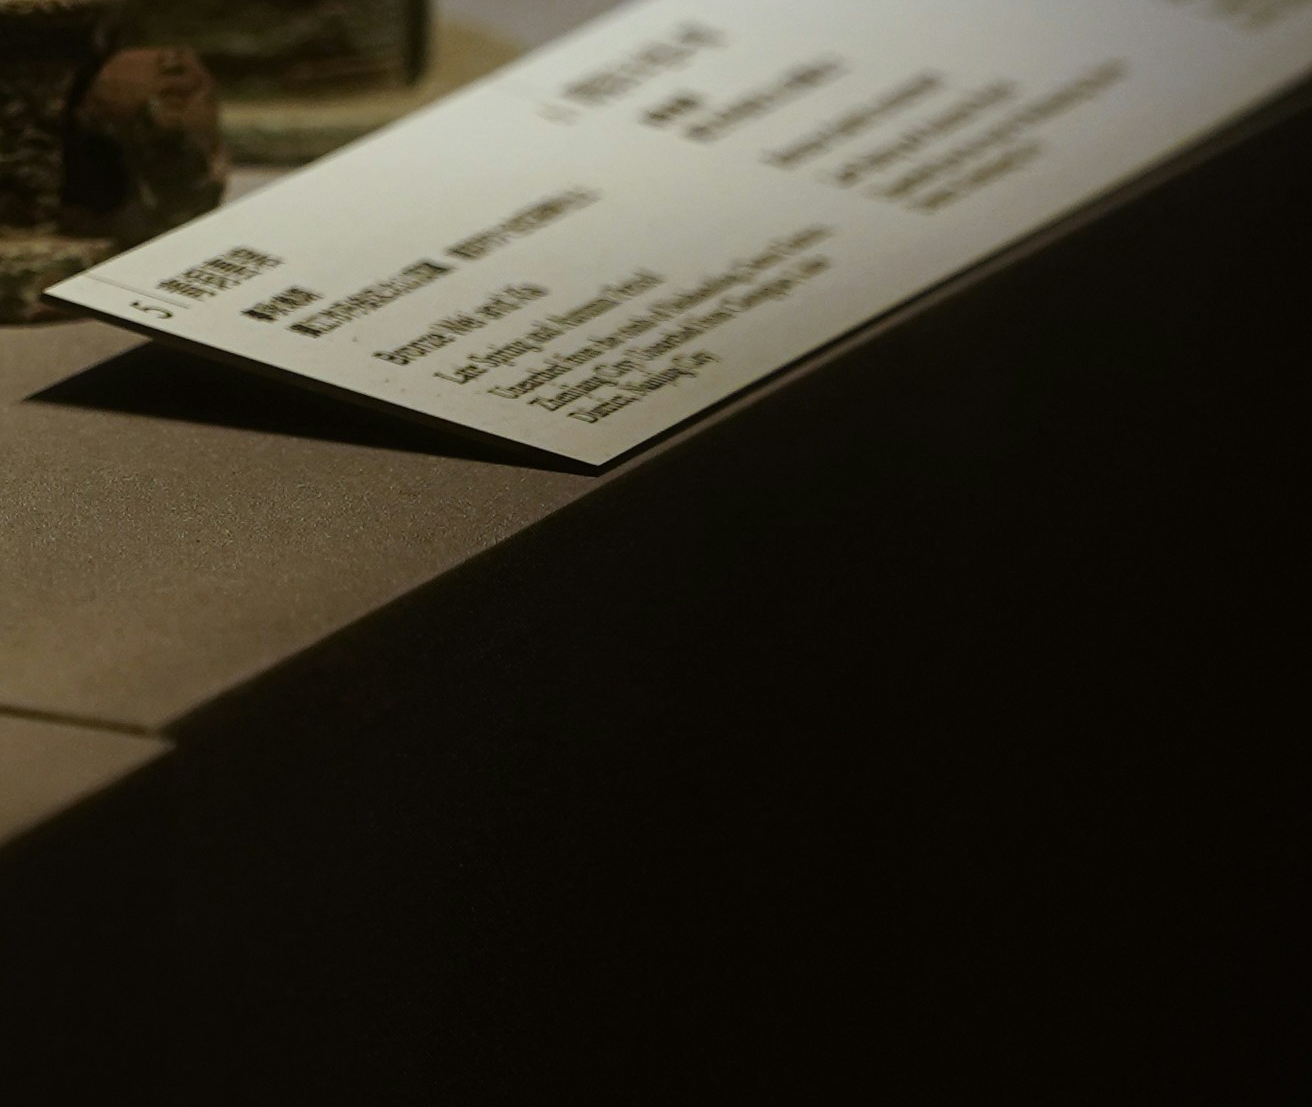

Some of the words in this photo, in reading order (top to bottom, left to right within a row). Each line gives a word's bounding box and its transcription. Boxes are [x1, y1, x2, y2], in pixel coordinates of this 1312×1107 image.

[130, 301, 173, 319] 5
[371, 331, 456, 366] Bronze
[429, 313, 488, 336] Wei
[474, 297, 522, 320] and
[432, 363, 490, 385] Late
[466, 338, 544, 368] Spring
[524, 320, 571, 344] and
[486, 359, 575, 399] Unearthed
[552, 346, 605, 367] from
[587, 335, 626, 351] the
[526, 375, 622, 417] Zhenjiang
[622, 324, 707, 362] Unearthed
[683, 310, 736, 330] from
[615, 365, 699, 398] Nanjing
[670, 349, 721, 373] City
